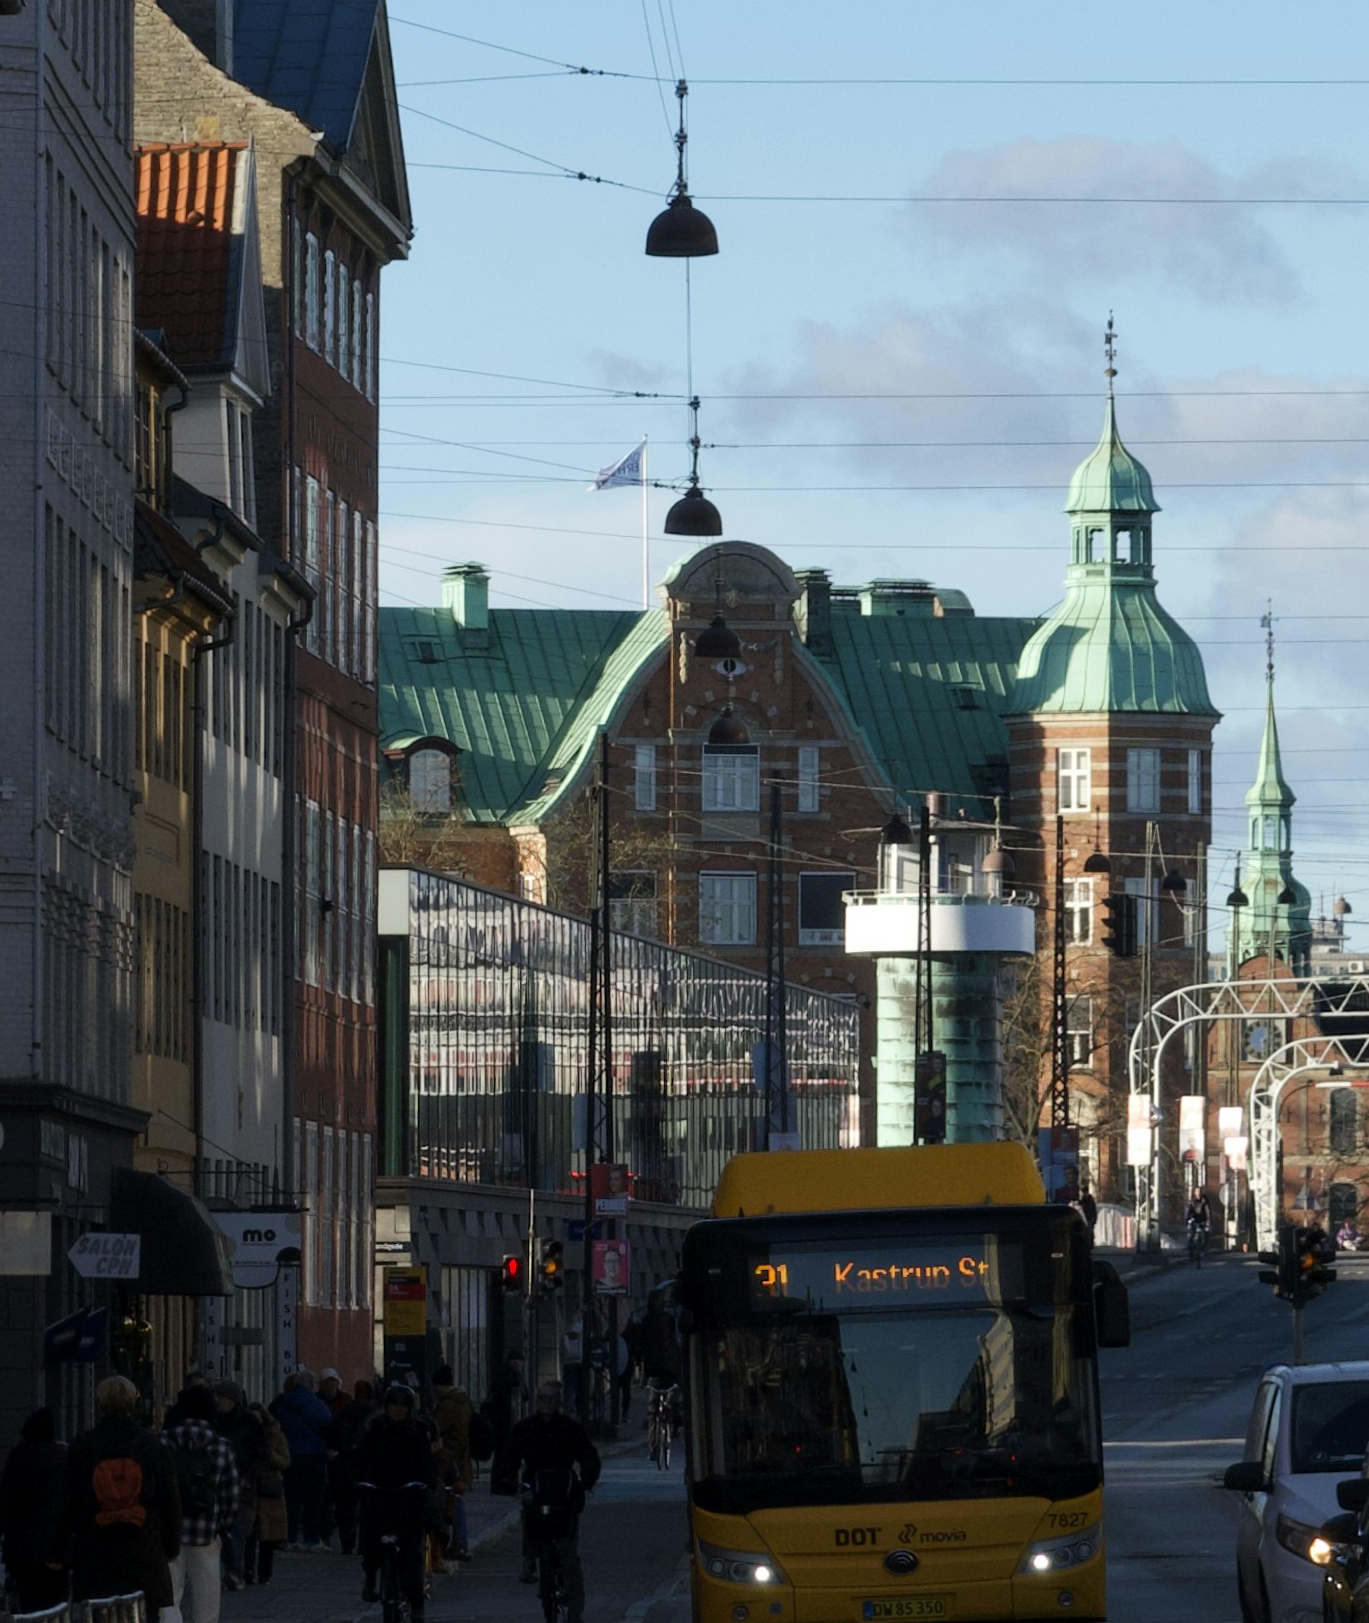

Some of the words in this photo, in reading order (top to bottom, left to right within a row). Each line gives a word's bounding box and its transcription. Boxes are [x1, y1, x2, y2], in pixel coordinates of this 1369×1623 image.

[243, 1229, 276, 1242] mo
[76, 1237, 137, 1256] SALON
[96, 1256, 133, 1275] CPH
[833, 1261, 951, 1294] Kastrup
[283, 1274, 292, 1329] FISH
[207, 1297, 215, 1344] ISH
[283, 1351, 292, 1374] BU
[1047, 1512, 1089, 1529] 7827
[835, 1529, 877, 1547] DOT
[919, 1529, 966, 1544] movia
[895, 1601, 914, 1617] 85
[915, 1600, 943, 1616] 350
